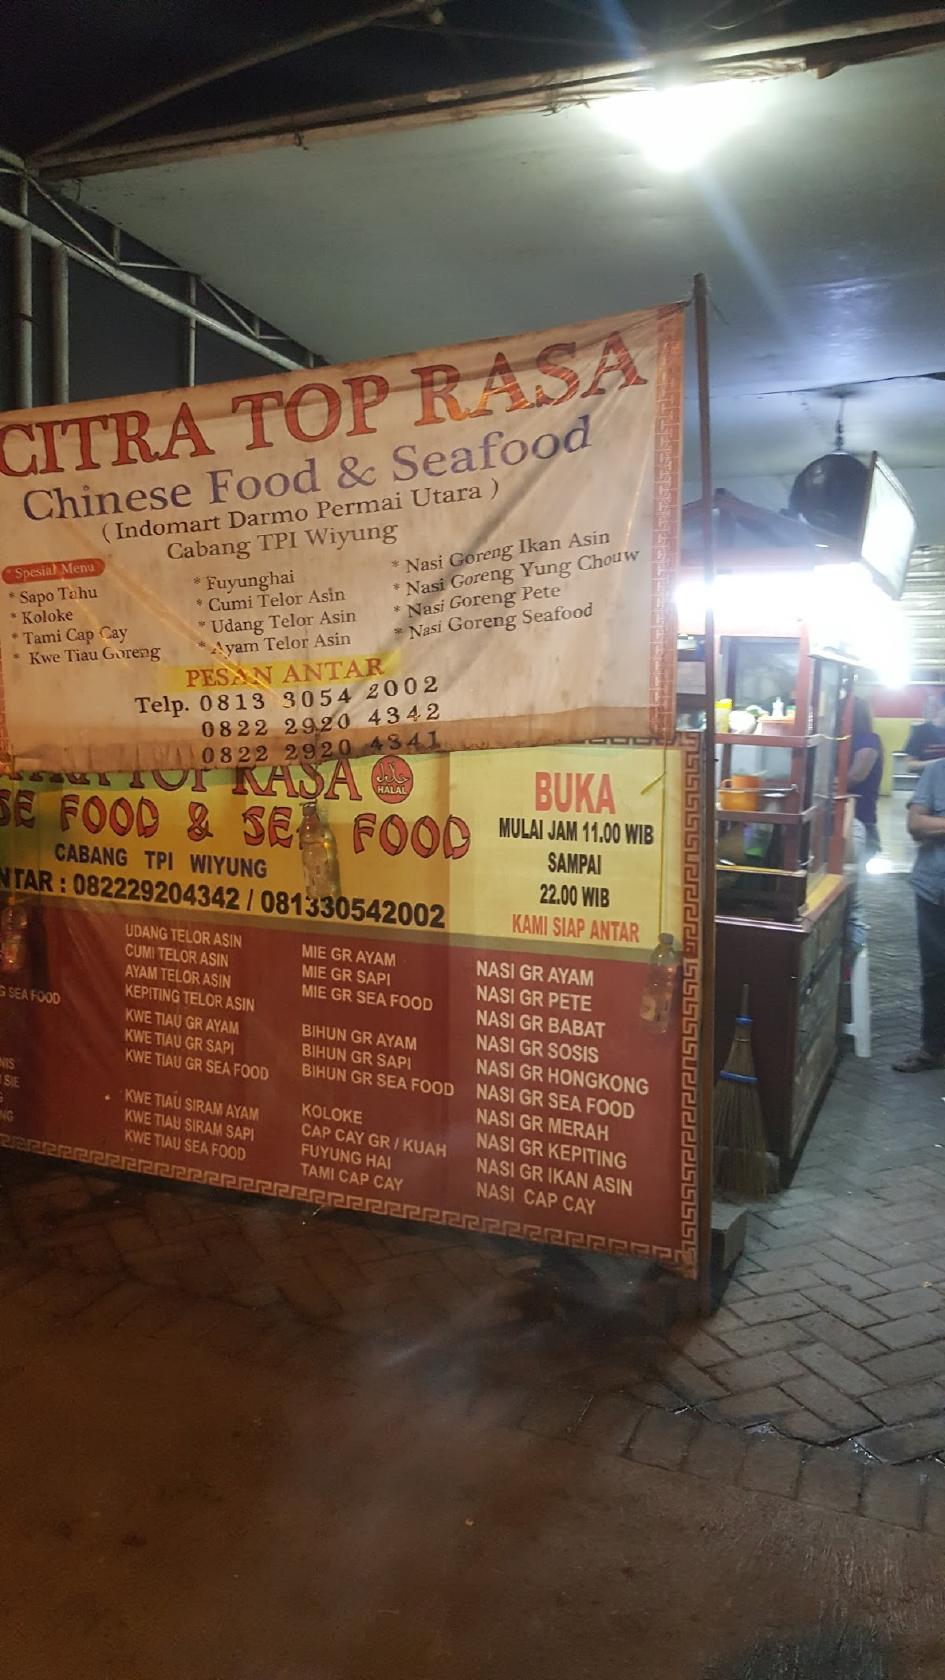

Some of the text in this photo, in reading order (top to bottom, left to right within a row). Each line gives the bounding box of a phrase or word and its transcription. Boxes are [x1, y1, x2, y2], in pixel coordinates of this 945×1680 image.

[0, 331, 647, 477] CITRA TOP RASA
[24, 414, 592, 520] Chinese Food & Seafood
[228, 505, 308, 529] Darmo
[317, 492, 402, 519] Permai
[410, 483, 483, 507] Utara
[167, 523, 398, 560] Cabang TPI Wiyung
[406, 531, 610, 574] Nasi Goreng Ikan Asin
[15, 563, 95, 582] Spesial Menu
[206, 570, 294, 594] Fuyunghai
[406, 550, 640, 596] Nasi Goreng Yung Chouw
[20, 587, 98, 607] Sapo Tahu
[208, 587, 345, 612] Cumi Telor Asin
[407, 585, 560, 619] Nasi Goreng Pete
[22, 609, 73, 625] Koloke
[211, 610, 356, 635] Udang Telor Asin
[409, 602, 593, 640] Nasi Goreng Seafood
[23, 626, 128, 645] Tami Cap Cay
[211, 632, 351, 659] Ayam Telor Asin
[29, 646, 160, 665] Kwe Tiau Goreng
[186, 657, 385, 688] PESAN ANTAR
[135, 676, 438, 718] Telp. 0813 3054 2002
[202, 703, 439, 738] 0822 2920 4342
[202, 731, 440, 764] 0822 2920 4341
[377, 786, 407, 795] HALAL
[535, 771, 616, 815] BUKA
[61, 794, 159, 838] FOOD
[187, 801, 213, 841] &
[353, 813, 470, 859] FOOD
[499, 817, 654, 845] MULAI JAM 11.00 WIB
[55, 843, 267, 878] CABANG TPI WIYUNG
[548, 852, 601, 875] SAMPAI
[73, 873, 240, 910] 082229204342
[261, 890, 445, 929] 081330542002
[540, 884, 610, 907] 22.00 WIB
[125, 924, 242, 948] UDANG TELOR ASIN
[512, 913, 639, 943] KAMI SIAP ANTAR
[125, 944, 228, 968] CUMI TELOR ASIN
[302, 944, 396, 967] MIE GR AYAM
[476, 960, 594, 987] NASI GR AYAM
[8, 988, 28, 1001] SEA
[31, 990, 61, 1005] FOOD
[125, 984, 255, 1012] KEPITING TELOR ASIN
[302, 984, 433, 1011] MIE GR SEA FOOD
[476, 985, 592, 1012] NASI GR PETE
[302, 1024, 417, 1050] BIHUN GR AYAM
[476, 1010, 606, 1039] NASI GR BABAT
[125, 1048, 269, 1080] KWE TIAU GR SEA FOOD
[476, 1034, 599, 1064] NASI GR SOSIS
[476, 1059, 649, 1096] NASI GR HONGKONG
[125, 1088, 259, 1121] KWE TIAU SIRAM AYAM
[302, 1103, 362, 1124] KOLOKE
[476, 1084, 635, 1119] NASI GR SEA FOOD
[301, 1123, 331, 1139] CAP
[335, 1128, 364, 1145] CAY
[368, 1133, 390, 1149] GR
[403, 1139, 446, 1157] KUAH
[476, 1133, 627, 1170] NASI GR KEPITING
[301, 1144, 391, 1170] FUYUNG HAI
[476, 1157, 632, 1196] NASI GR IKAN ASIN
[476, 1182, 596, 1215] NASI CAP CAY
